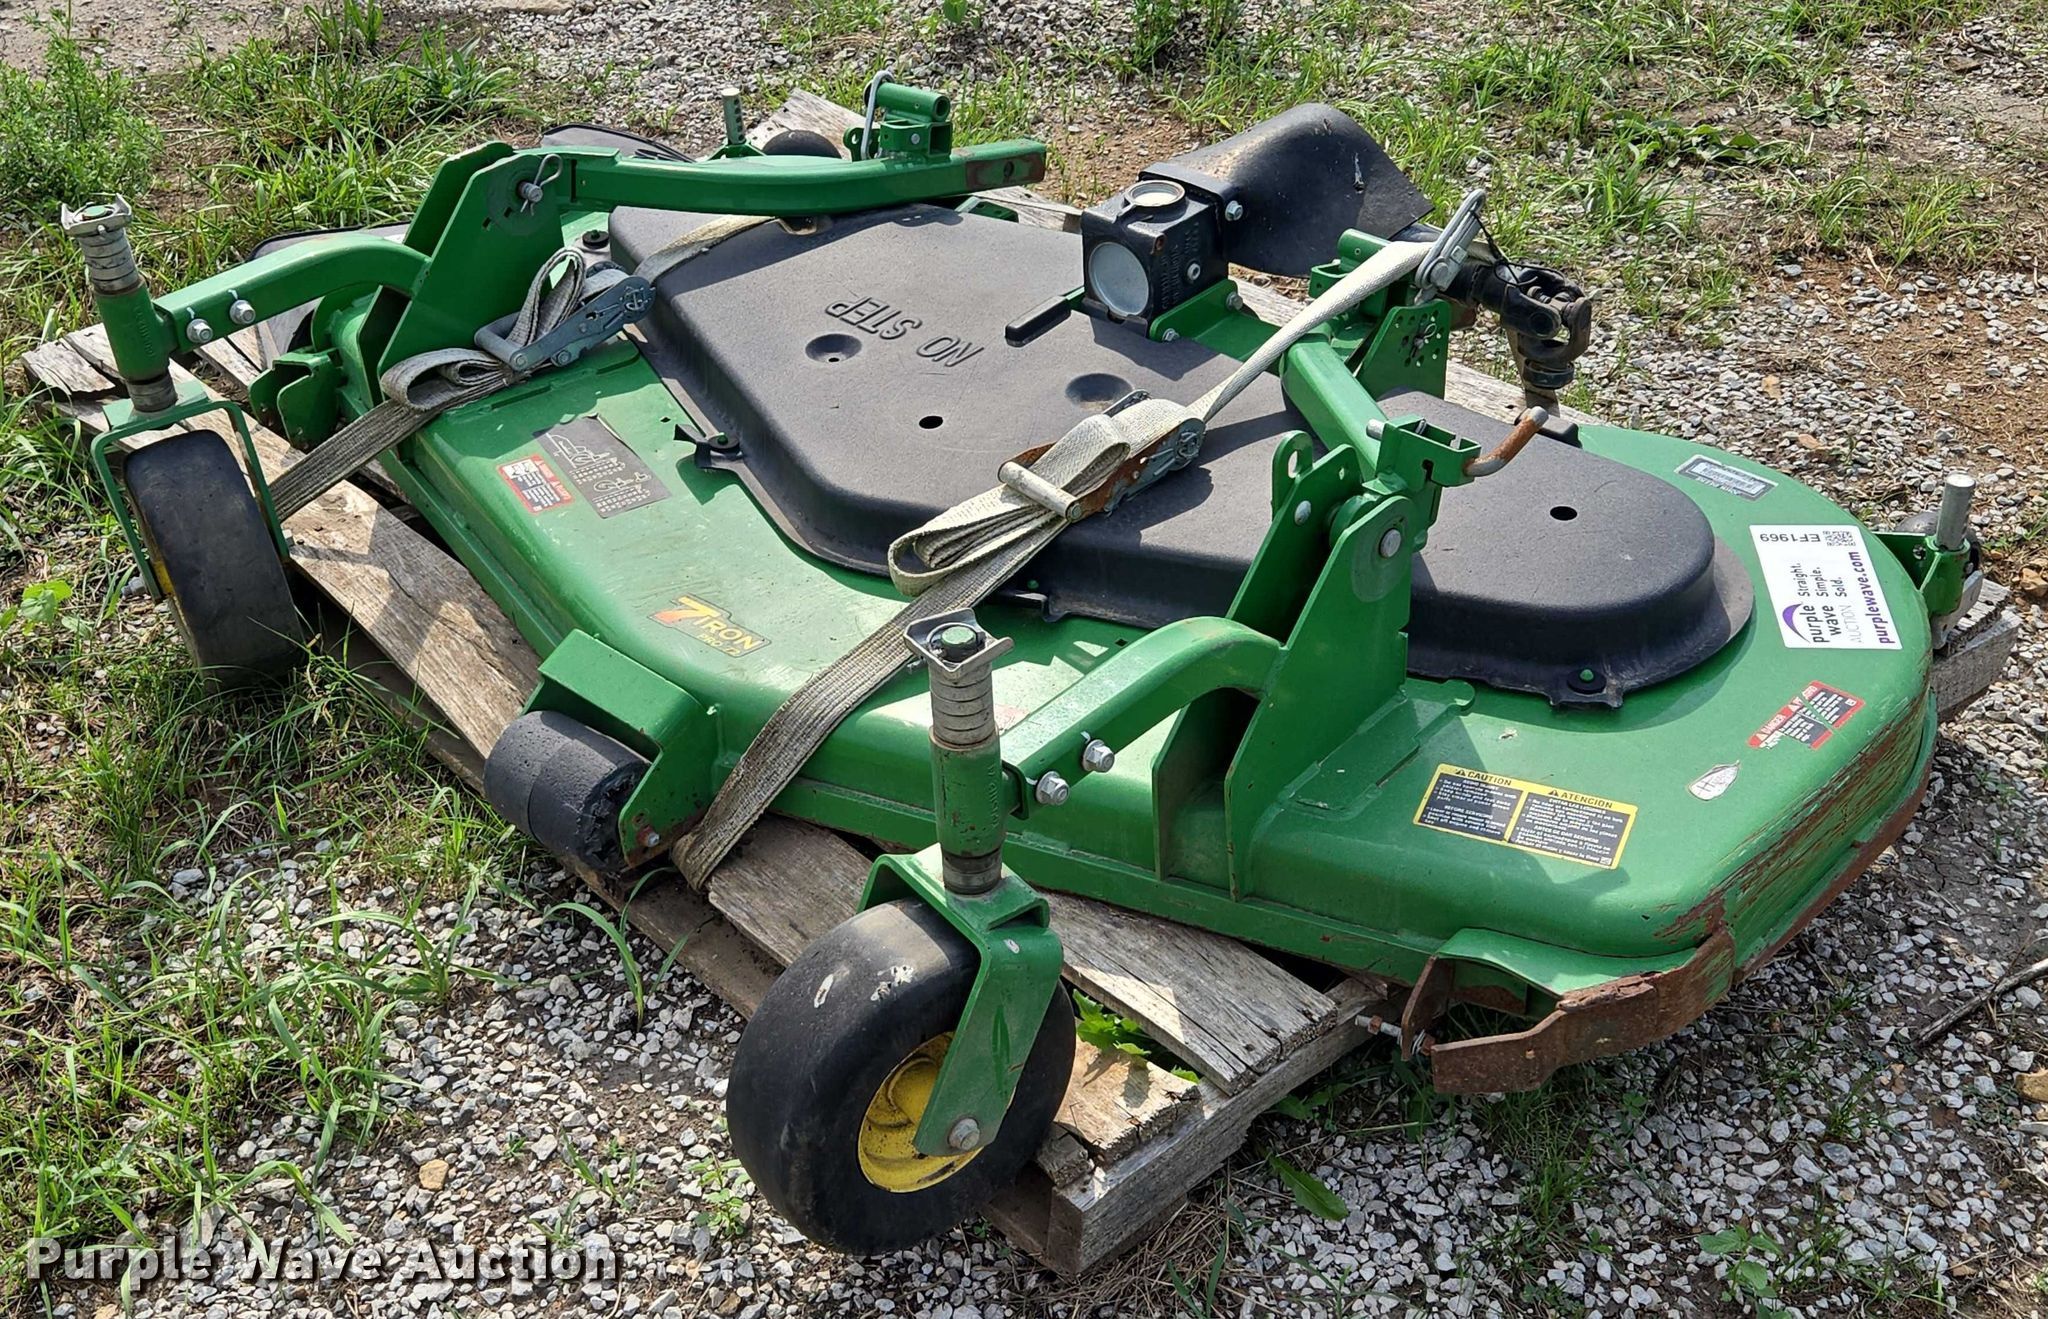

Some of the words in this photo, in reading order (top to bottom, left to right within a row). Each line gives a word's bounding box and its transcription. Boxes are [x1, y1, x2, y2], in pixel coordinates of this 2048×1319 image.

[825, 297, 923, 341] STEP
[916, 335, 985, 367] NO
[1759, 533, 1821, 543] EF1969
[1791, 563, 1810, 597] Straight.
[1810, 567, 1829, 597] Simple.
[1830, 577, 1847, 597] Sold.
[1848, 551, 1896, 644] purplewave.com
[1799, 605, 1830, 643] purple
[1822, 605, 1842, 636] wave
[1467, 771, 1512, 786] CAUTION
[1560, 792, 1613, 809] ATENCION
